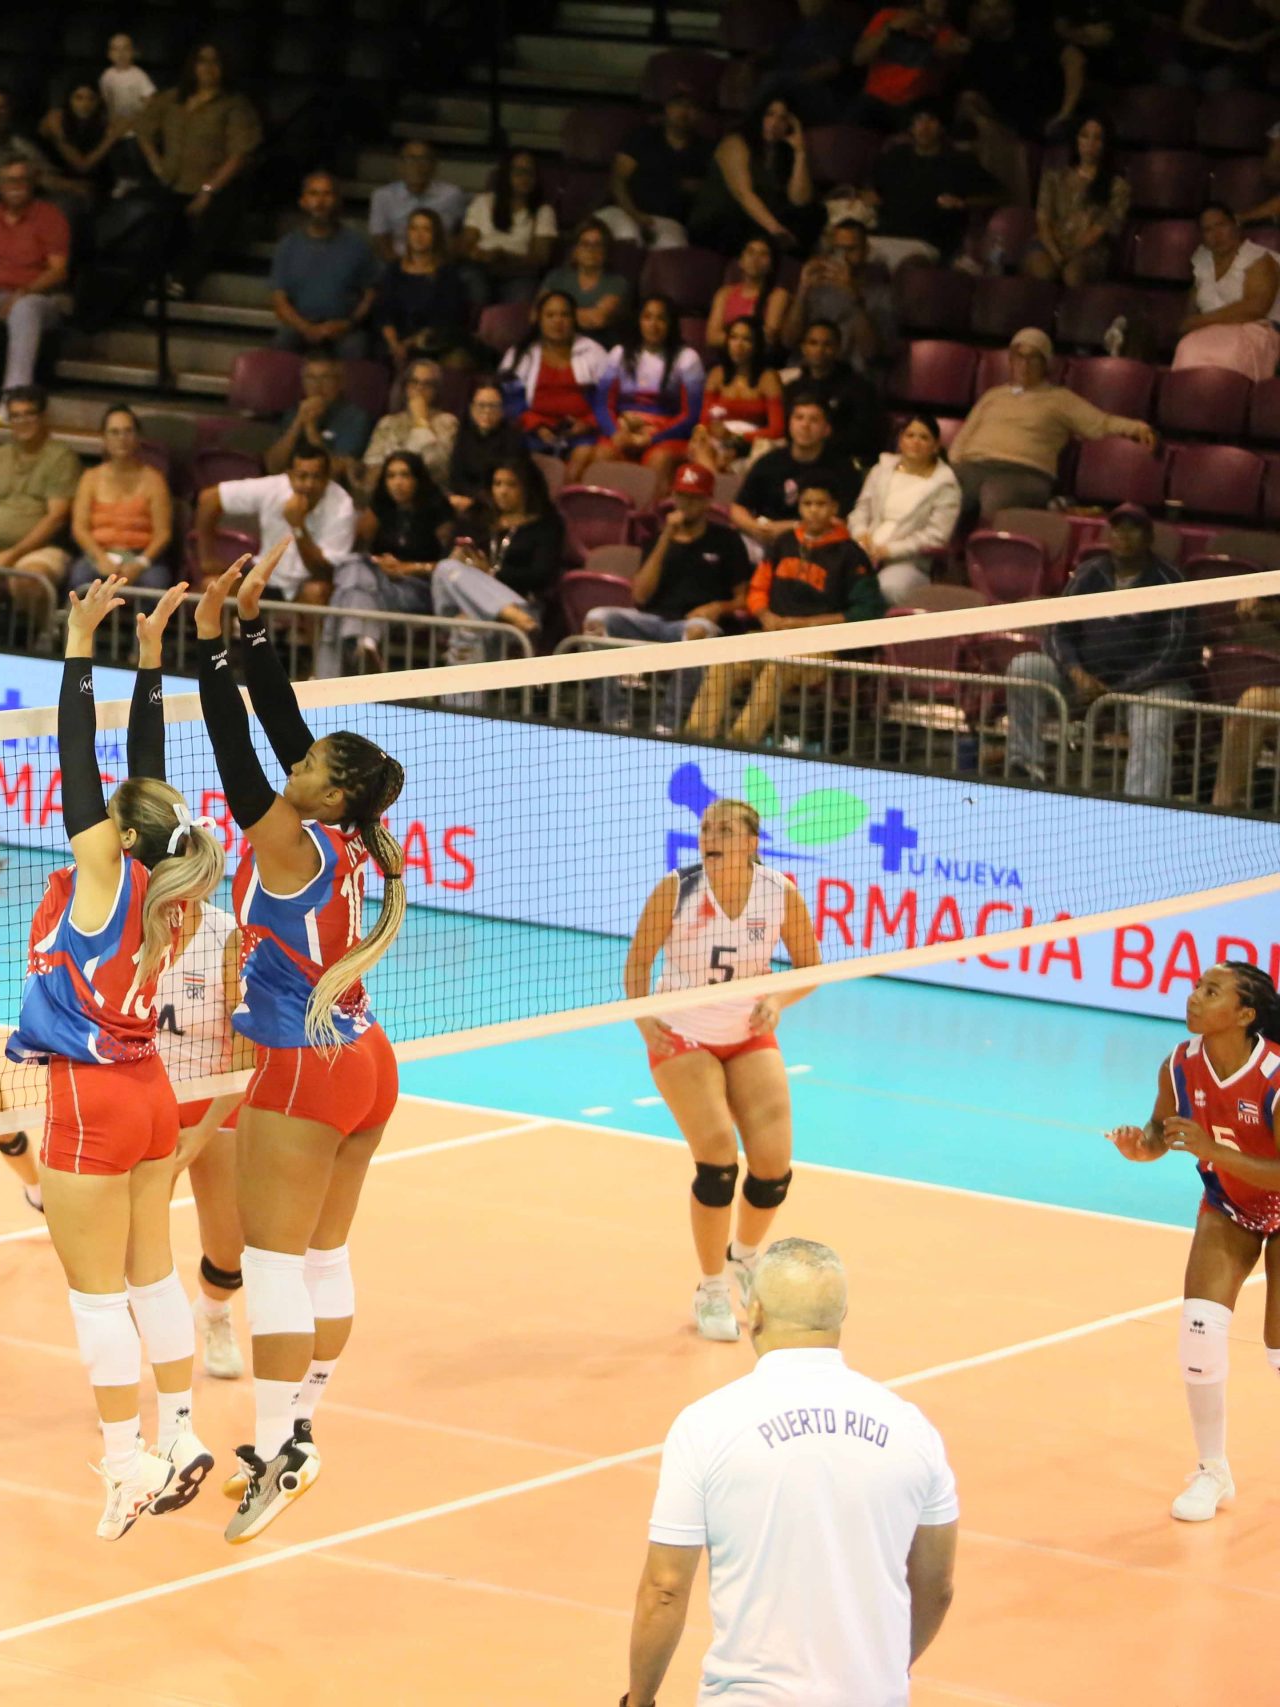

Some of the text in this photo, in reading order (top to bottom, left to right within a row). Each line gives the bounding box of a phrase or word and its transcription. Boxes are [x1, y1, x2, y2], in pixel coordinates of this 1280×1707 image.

[933, 858, 1023, 890] NUEVA
[748, 928, 765, 942] CRC
[784, 872, 1083, 981] RMACIA
[707, 945, 738, 985] 5
[186, 985, 206, 1000] CRC
[1237, 1112, 1260, 1125] PUR
[757, 1407, 890, 1449] PUERTO RICO
